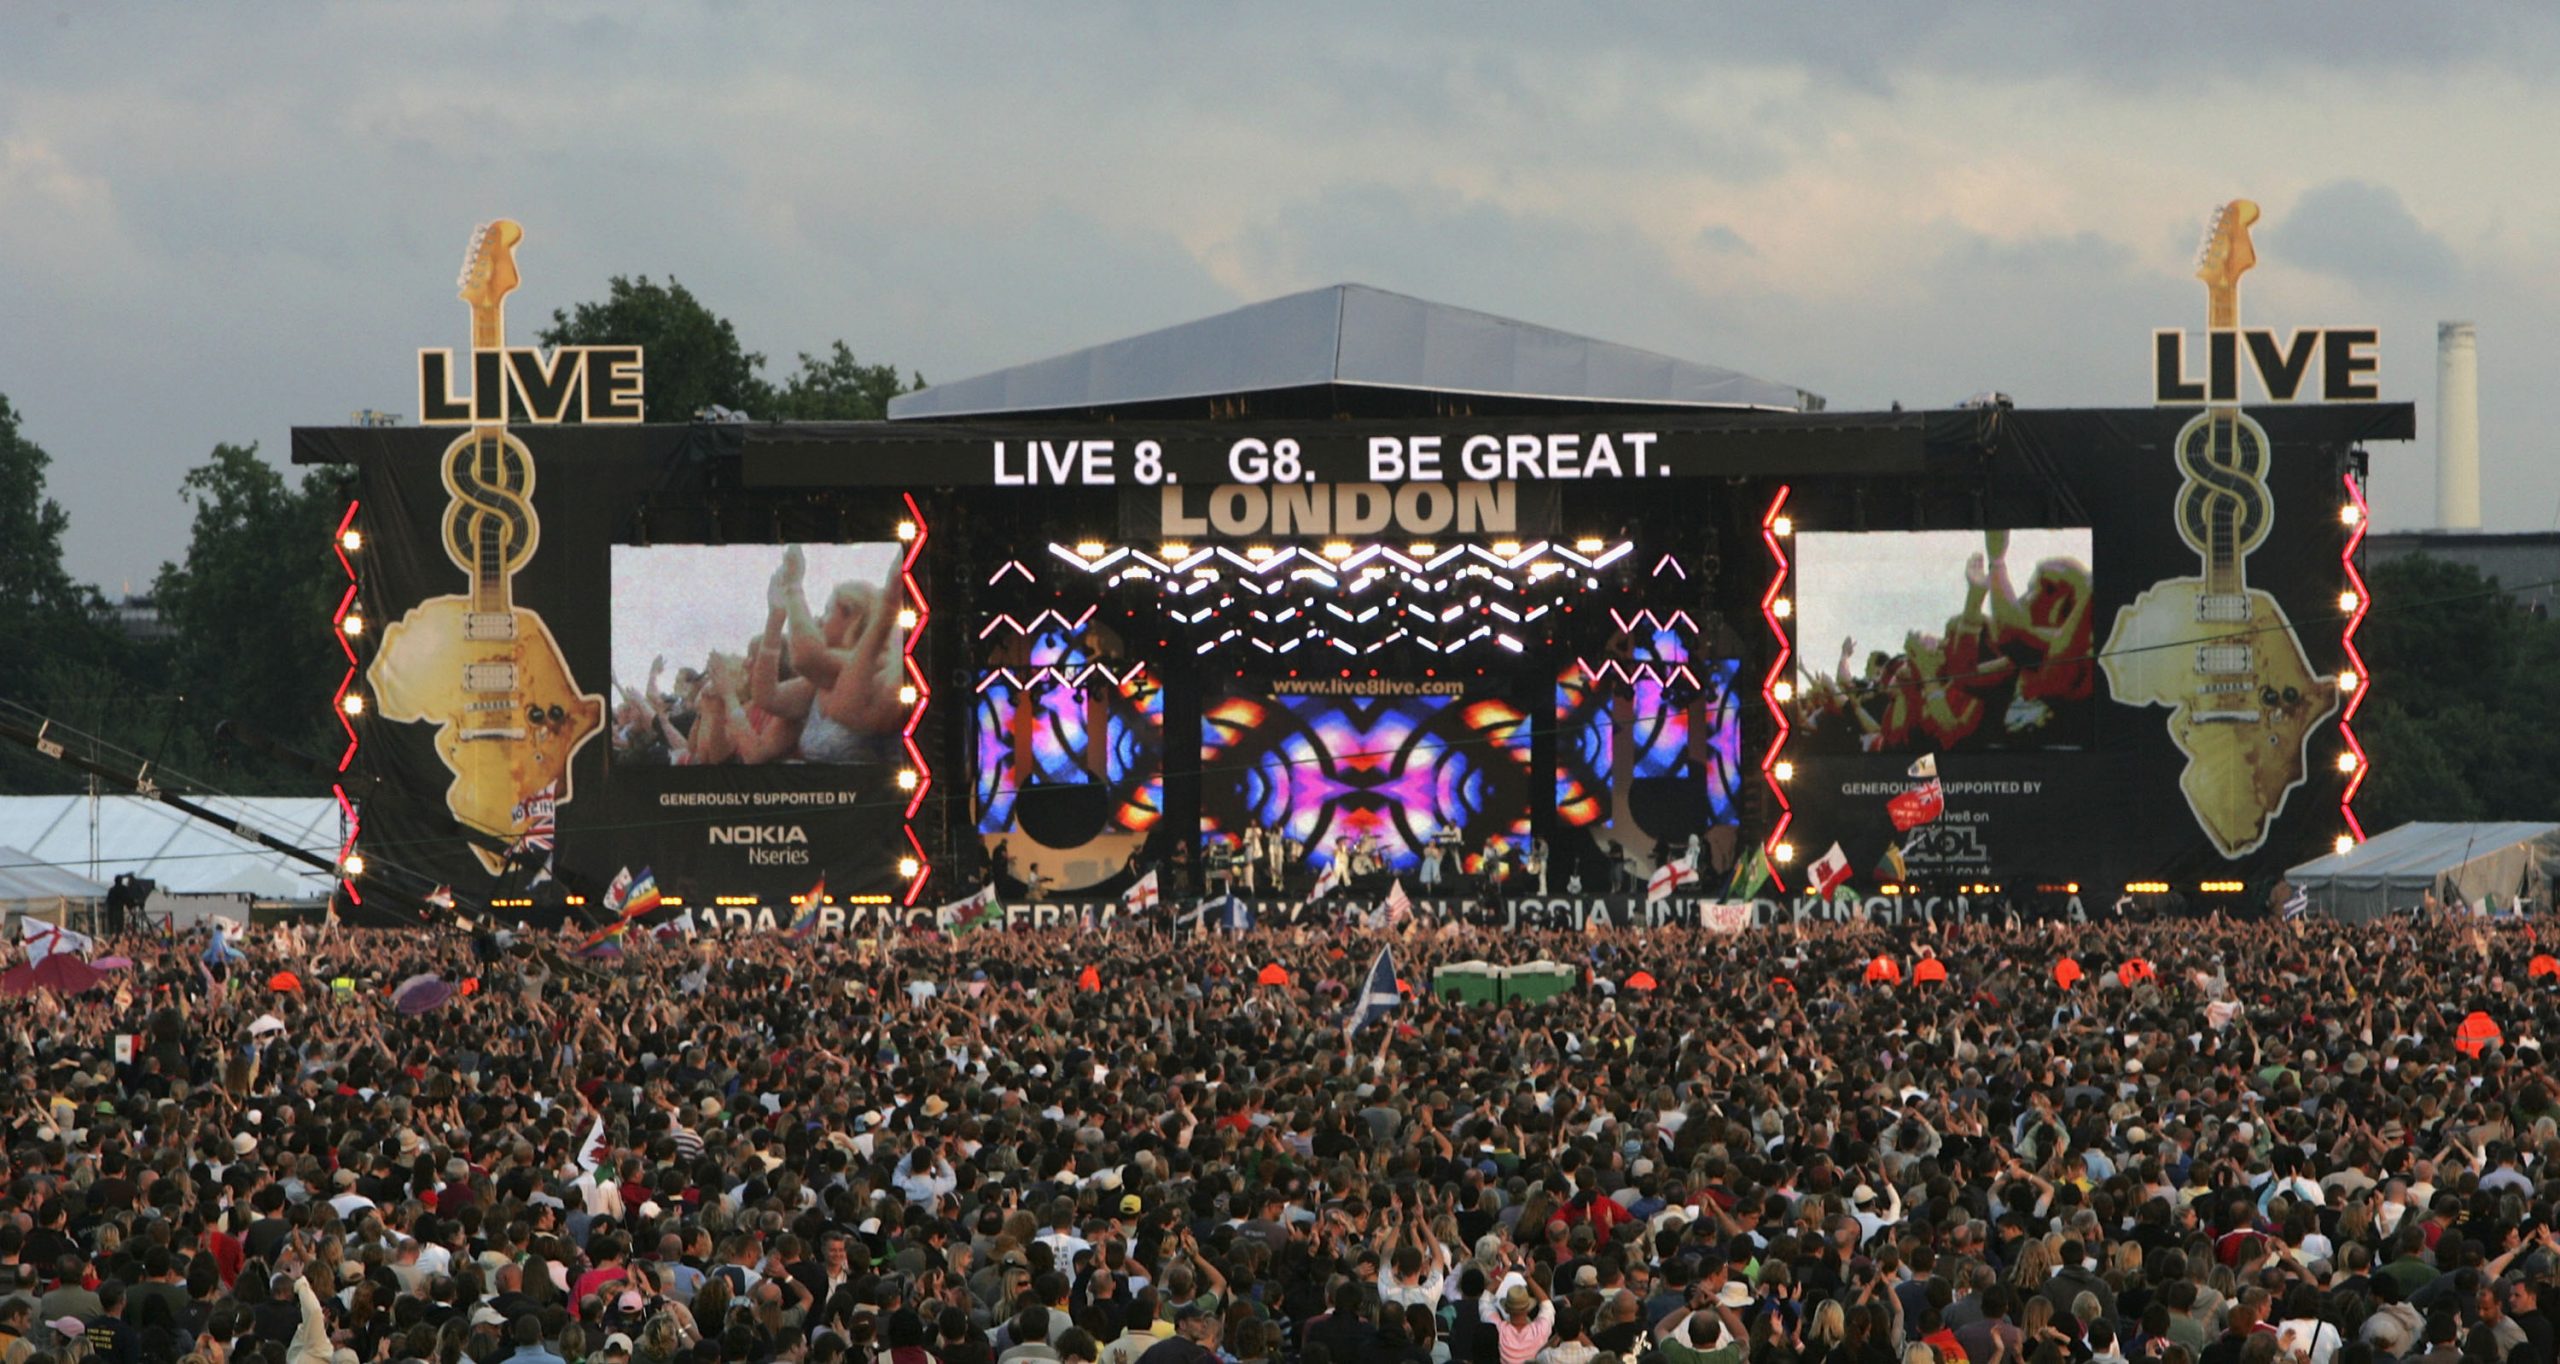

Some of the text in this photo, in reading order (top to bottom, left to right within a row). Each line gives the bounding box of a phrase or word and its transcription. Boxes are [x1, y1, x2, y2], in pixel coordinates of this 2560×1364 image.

[2153, 327, 2380, 404] LIVE
[418, 345, 644, 425] LIVE
[994, 432, 1671, 485] LIVE 8. G8. BE GREAT.
[1161, 482, 1516, 536] LONDON
[1272, 679, 1464, 695] www.live8live.com
[1943, 782, 2020, 794] UPPORTED
[2023, 782, 2041, 794] BY
[660, 792, 857, 806] GENEROUSLY SUPPORTED BY
[709, 825, 808, 845] NOKIA
[748, 846, 809, 865] Nseries
